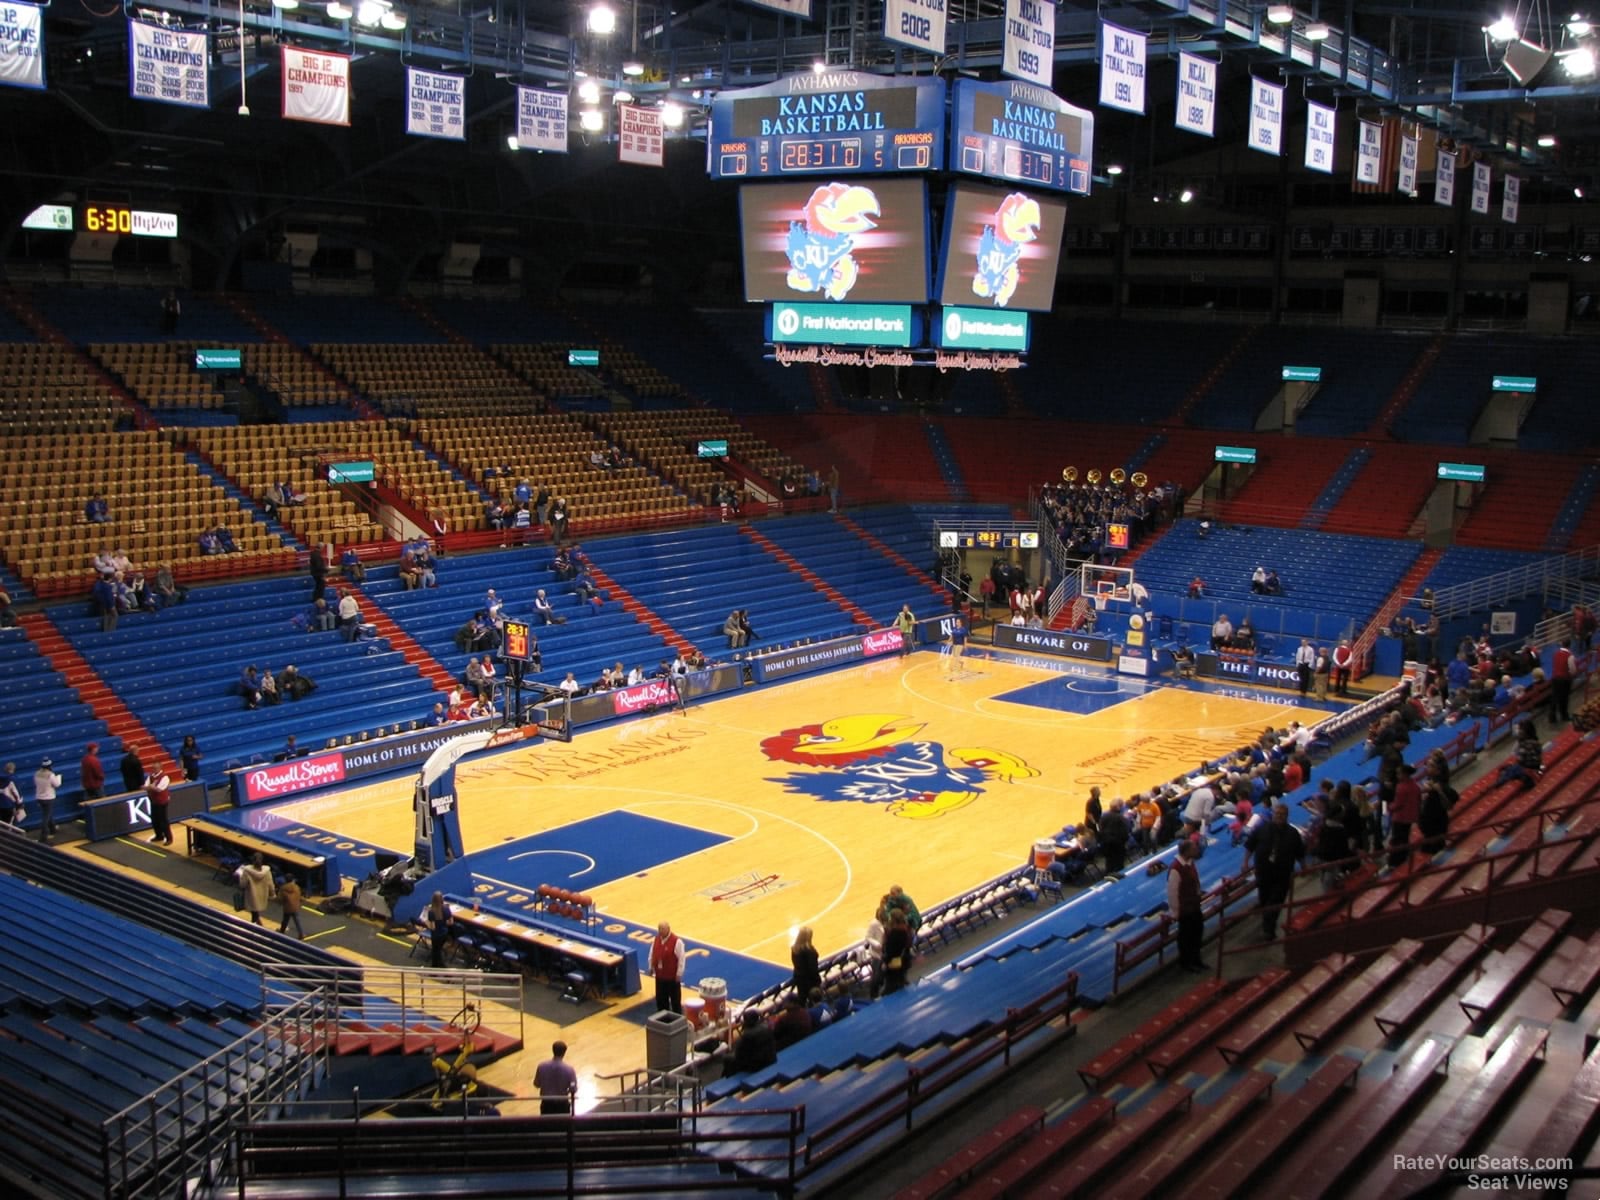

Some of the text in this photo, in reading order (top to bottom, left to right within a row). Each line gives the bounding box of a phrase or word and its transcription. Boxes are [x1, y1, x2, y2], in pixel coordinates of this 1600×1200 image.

[1019, 0, 1042, 26] NCAA
[901, 11, 931, 41] 2002
[1008, 18, 1051, 49] FINAL FOUR
[153, 31, 189, 49] BIG 12
[1114, 34, 1134, 57] NCAA
[137, 43, 203, 67] CHAMPIONS
[303, 56, 332, 71] BIG 12
[1018, 49, 1039, 75] 1993
[1105, 54, 1143, 78] FINAL FOUR
[1188, 62, 1206, 83] NCAA
[288, 68, 346, 88] CHAMPIONS
[415, 73, 458, 91] BIG EIGHT
[789, 73, 858, 93] JAYHAWKS
[411, 87, 461, 105] CHAMPIONS
[524, 91, 562, 107] BIG EIGHT
[1114, 81, 1131, 103] 1991
[521, 104, 565, 120] CHAMPIONS
[780, 92, 864, 115] KANSAS
[626, 109, 658, 125] BIG EIGHT
[762, 112, 884, 135] BASKETBALL
[1005, 100, 1055, 129] KANSAS
[623, 121, 661, 136] CHAMPIONS
[992, 118, 1065, 150] BASKETBALL
[721, 143, 747, 152] KANSAS
[894, 133, 932, 145] ARKANSAS
[736, 155, 745, 173] 0
[760, 156, 768, 172] 5
[845, 148, 854, 166] 0
[875, 151, 882, 167] 5
[916, 148, 926, 166] 0
[87, 208, 131, 232] 6:30
[803, 316, 904, 331] First National Bank
[775, 343, 913, 368] Russell Stover Candies
[509, 635, 525, 656] 30
[1016, 633, 1090, 652] BEWARE OF
[765, 643, 863, 672] HOME OF THE KANSAS JAYHAWKS
[1221, 661, 1300, 681] THE PHOG
[616, 688, 649, 708] Russell
[345, 752, 378, 769] HOME
[380, 749, 394, 761] OF
[399, 743, 418, 756] THE
[251, 761, 340, 791] Russell Stover
[856, 757, 938, 782] KU
[282, 774, 336, 792] CANDIES
